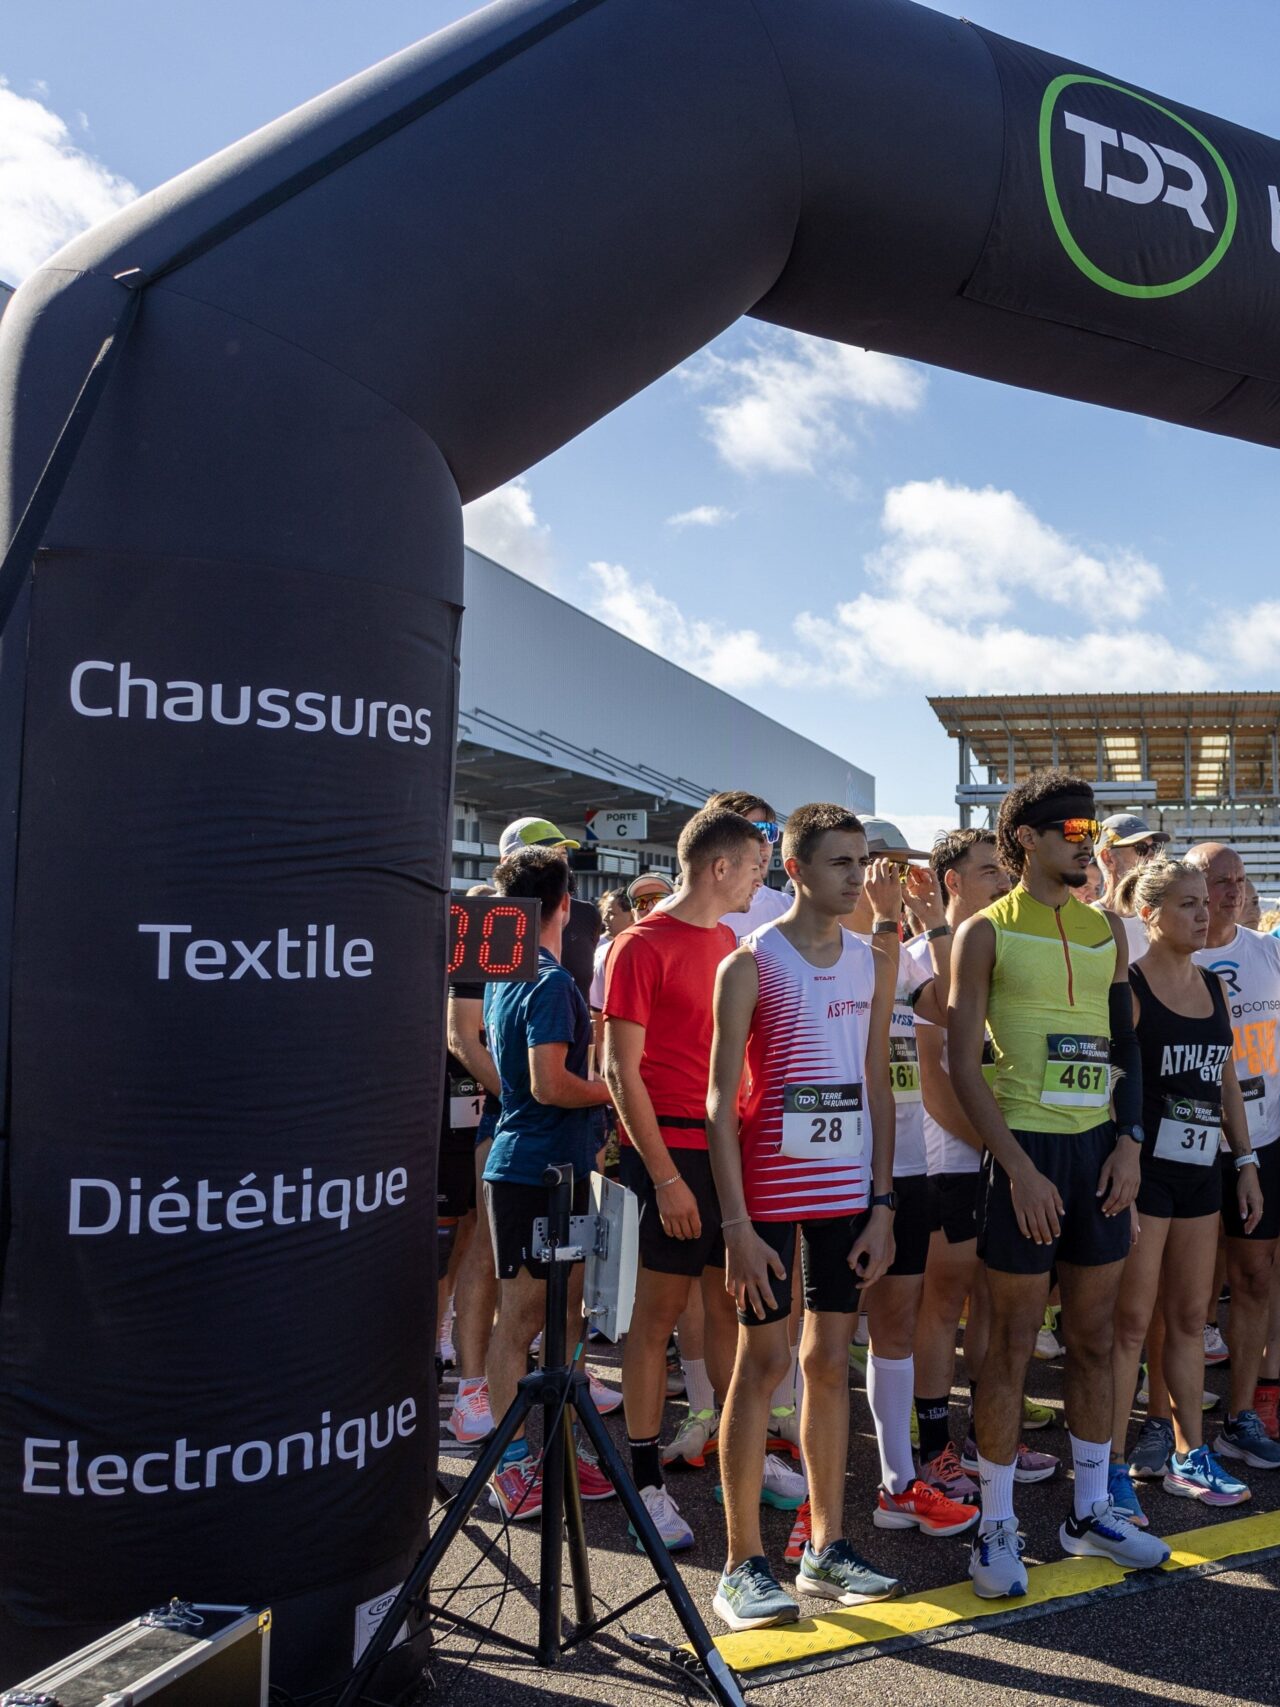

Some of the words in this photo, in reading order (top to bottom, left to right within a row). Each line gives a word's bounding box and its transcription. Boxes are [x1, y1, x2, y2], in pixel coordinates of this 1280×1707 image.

[1064, 111, 1215, 234] TDR
[70, 660, 432, 746] Chaussures
[606, 812, 638, 821] PORTE
[617, 824, 628, 837] C
[774, 858, 782, 868] D
[138, 923, 374, 981] Textile
[828, 999, 856, 1019] ASPTT
[1061, 1044, 1076, 1053] TDR
[1080, 1042, 1097, 1050] TERRE
[1059, 1064, 1103, 1090] 467
[798, 1095, 817, 1105] TDR
[820, 1092, 843, 1100] TERRE
[830, 1098, 859, 1108] RUNNING
[1176, 1106, 1192, 1116] TDR
[1194, 1107, 1213, 1116] TERRE
[810, 1117, 843, 1143] 28
[1180, 1127, 1208, 1152] 31
[68, 1166, 409, 1236] Diététique
[22, 1397, 418, 1496] Electronique
